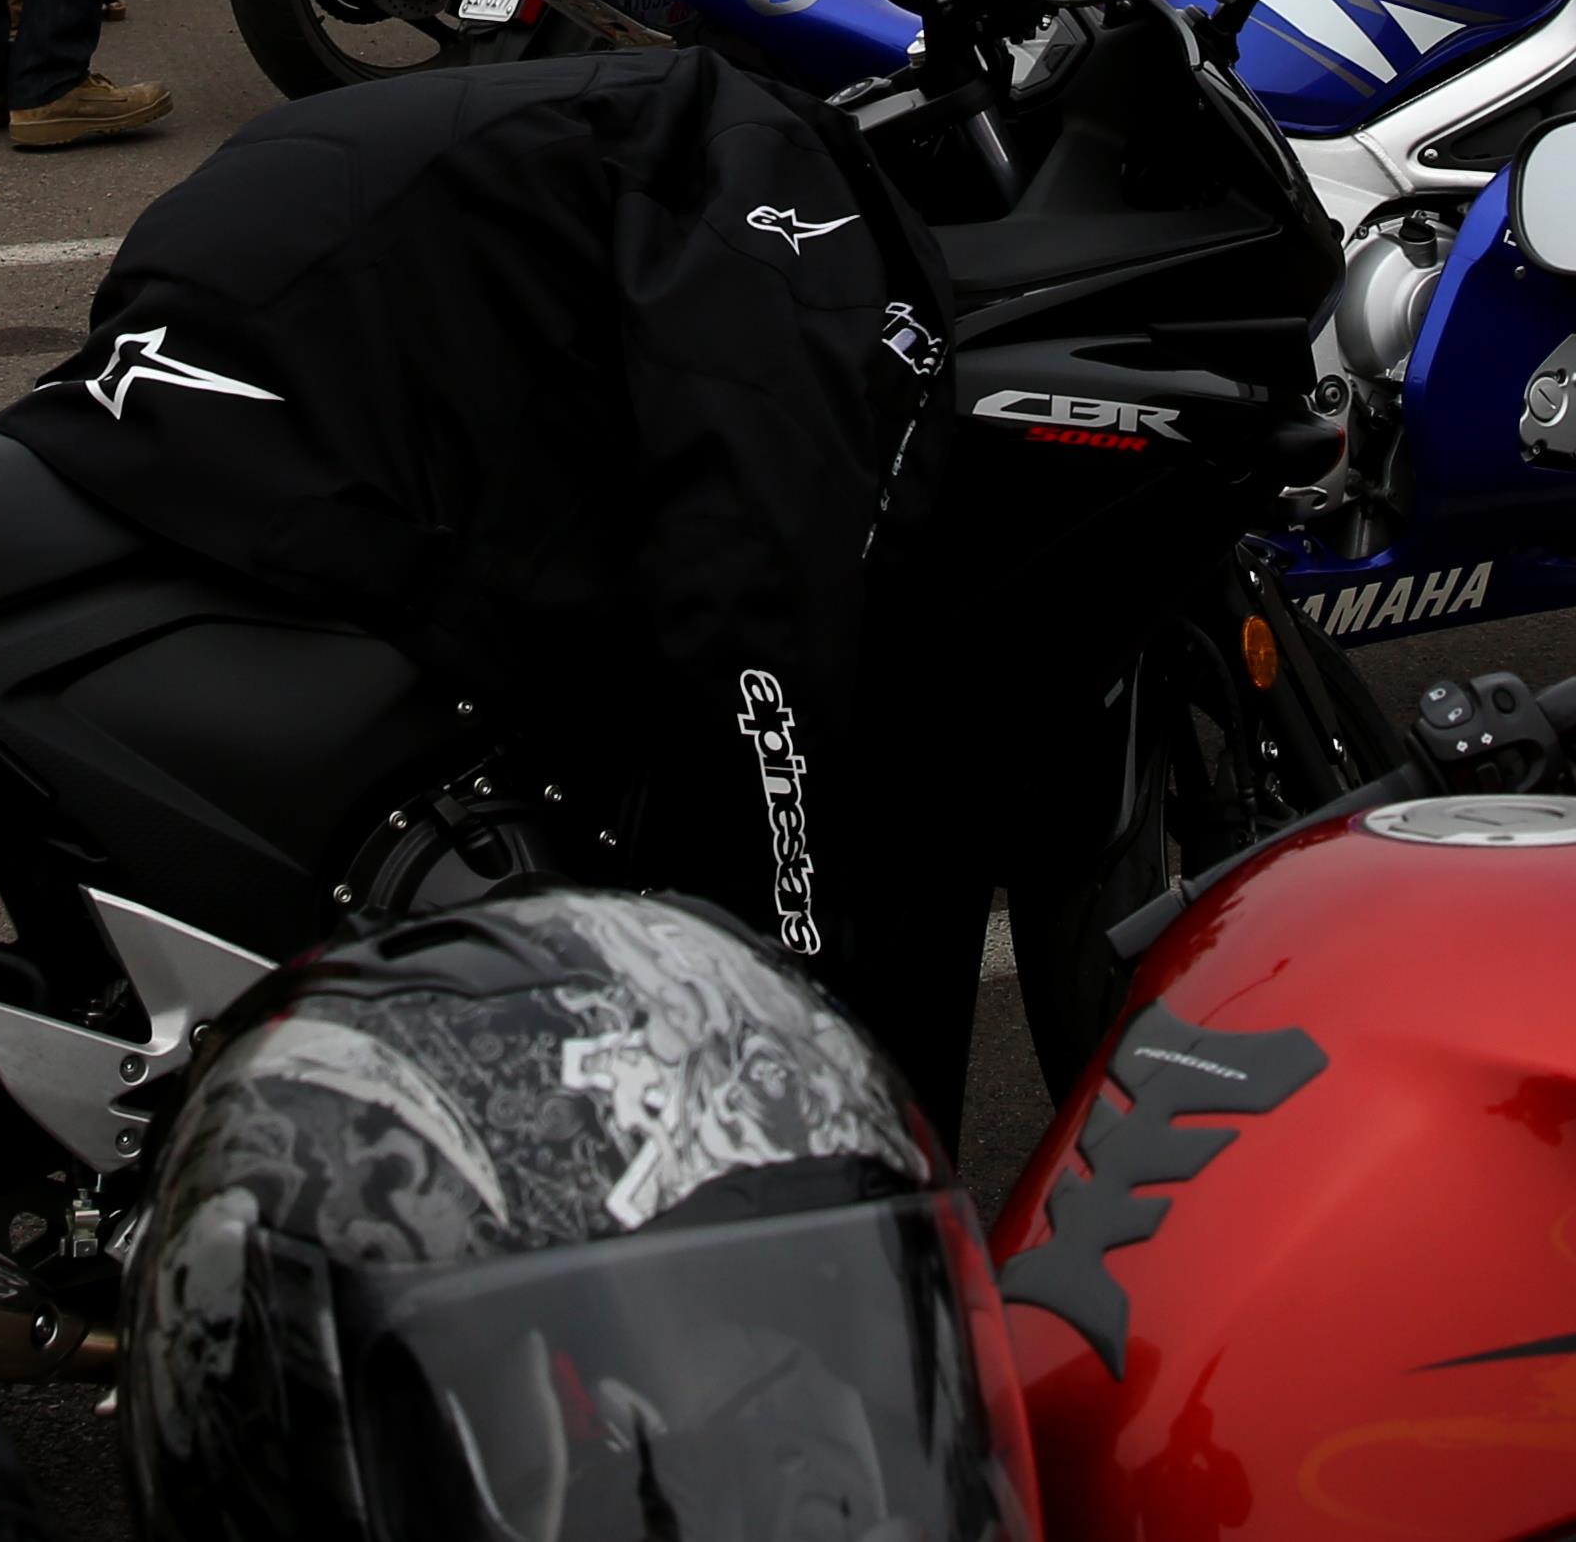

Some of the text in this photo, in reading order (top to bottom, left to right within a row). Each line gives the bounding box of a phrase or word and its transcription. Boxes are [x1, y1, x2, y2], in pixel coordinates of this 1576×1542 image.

[972, 390, 1192, 443] CBR
[1026, 426, 1149, 451] 500R
[1292, 561, 1494, 636] AMAHA
[737, 669, 822, 955] alpinestars
